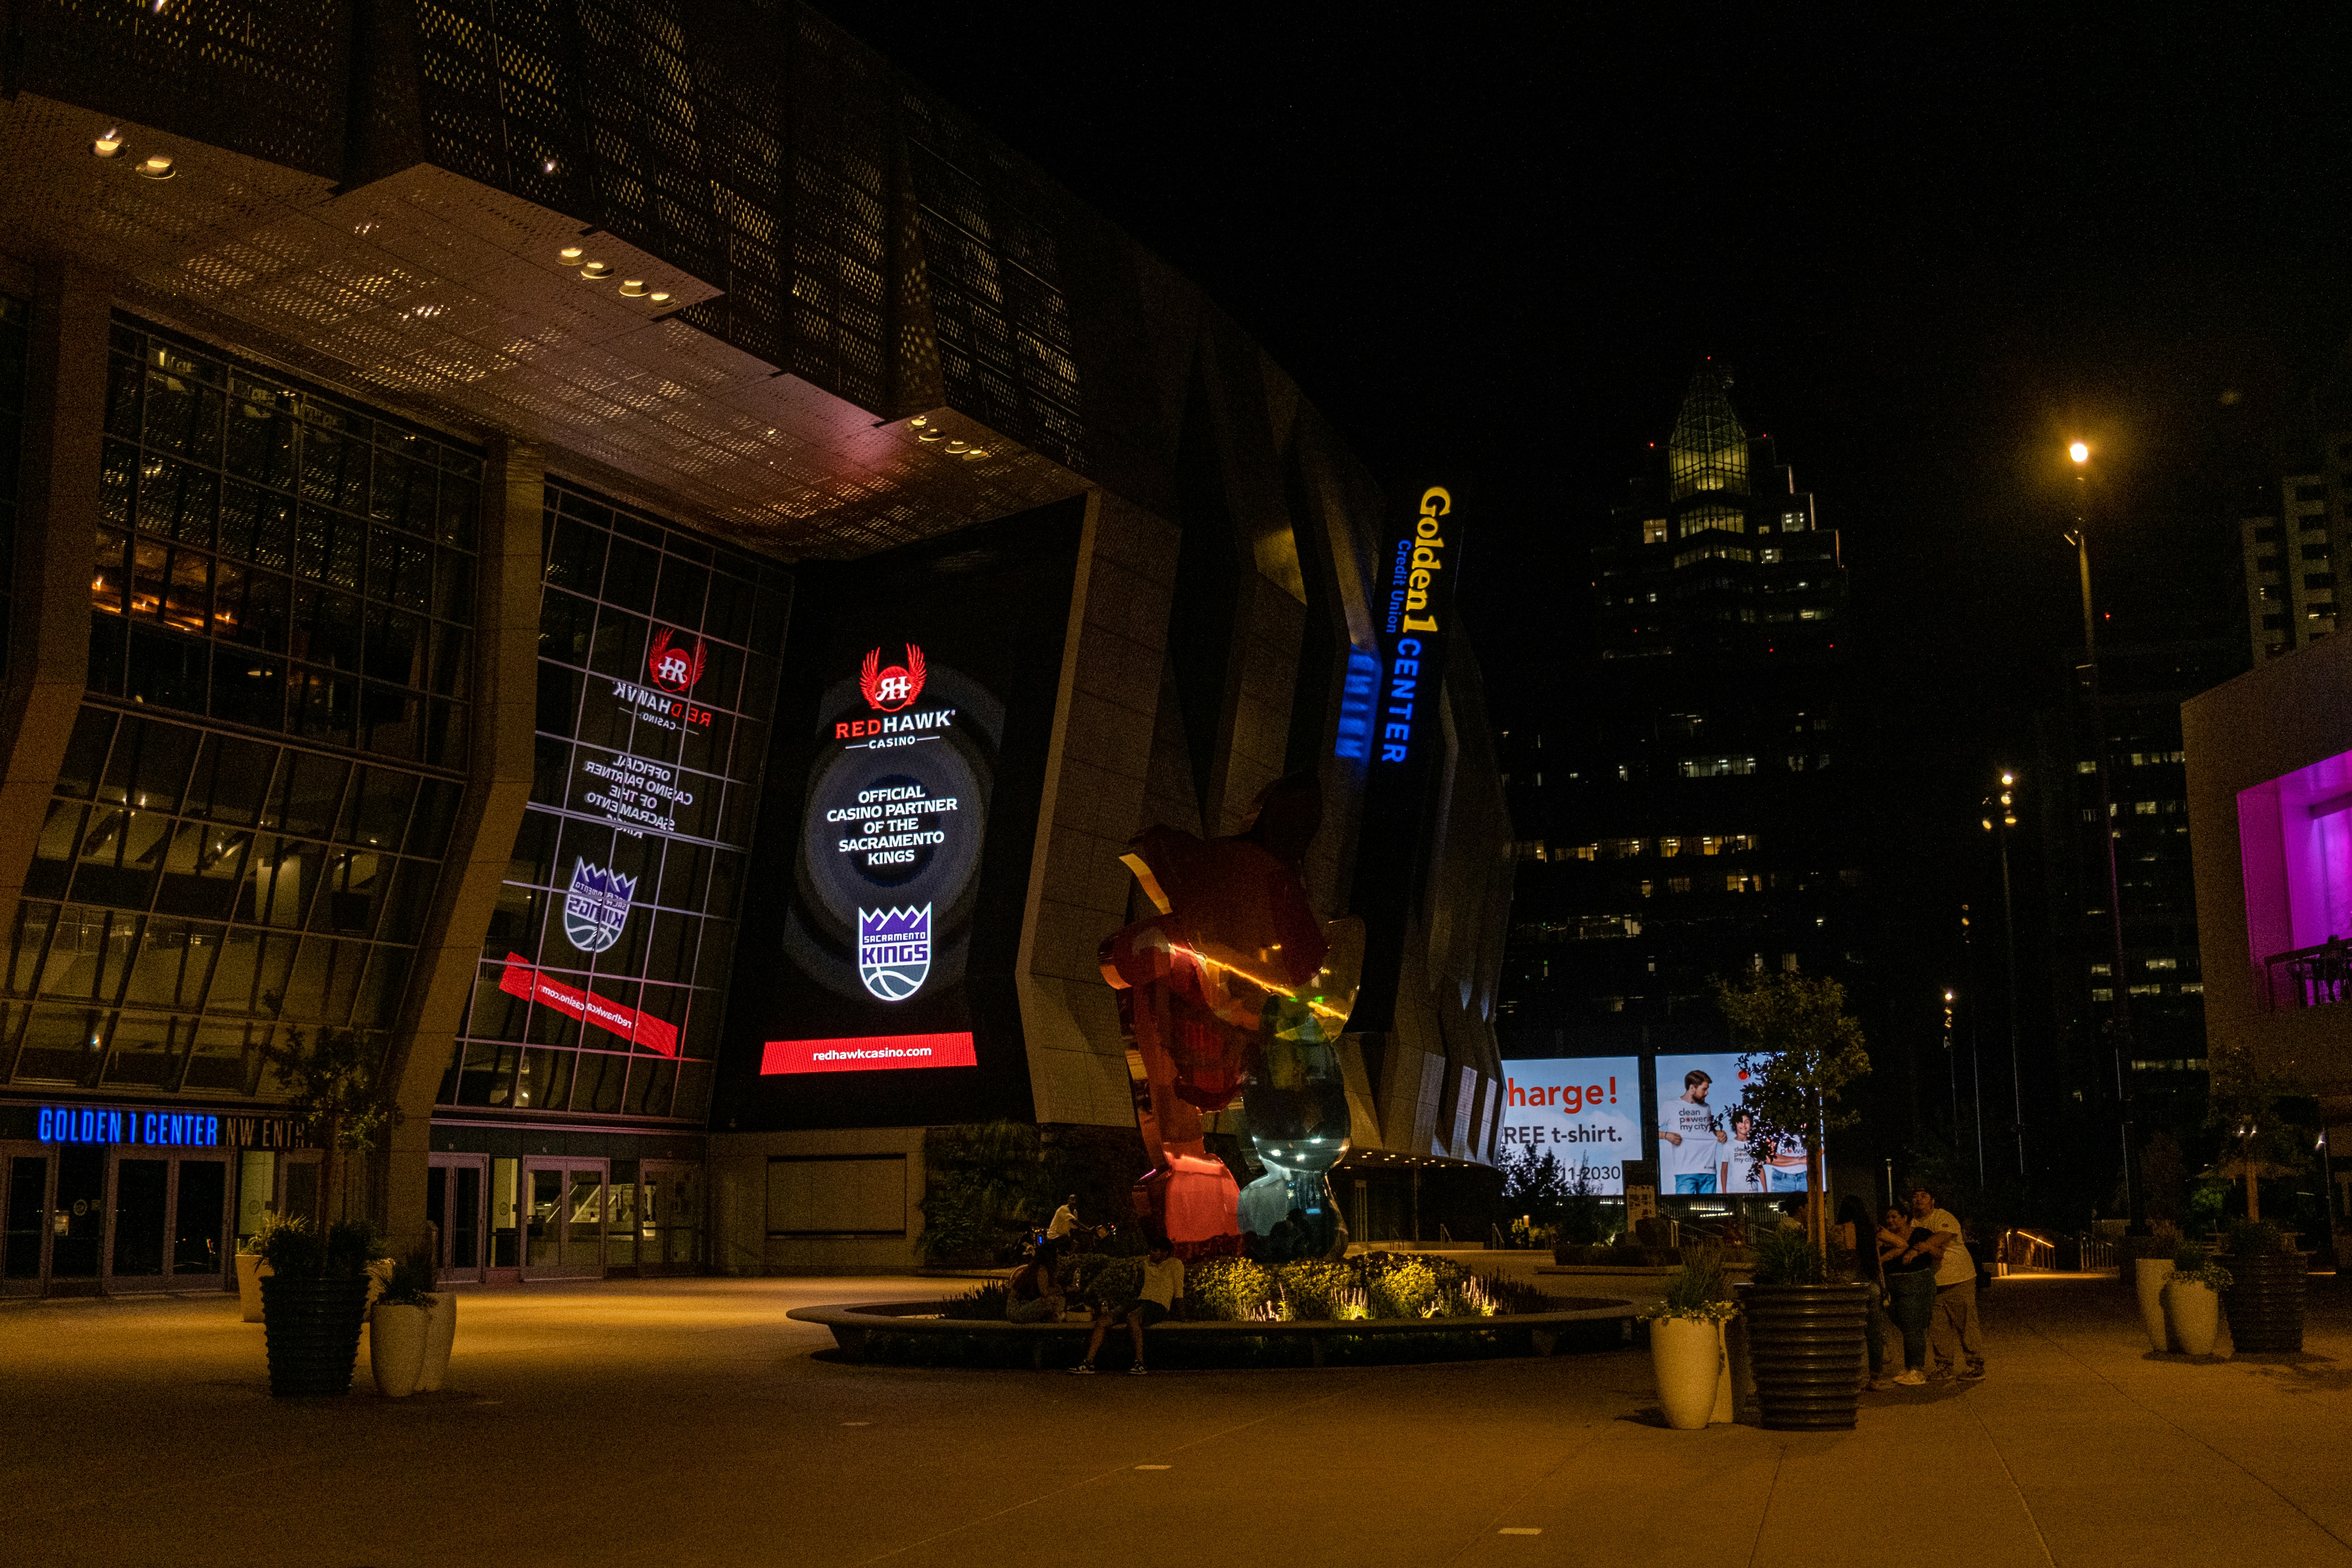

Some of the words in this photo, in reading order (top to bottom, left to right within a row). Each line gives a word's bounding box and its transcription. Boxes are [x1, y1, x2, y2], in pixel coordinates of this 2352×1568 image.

[1405, 486, 1451, 611] Golden
[1393, 539, 1412, 586] Credit
[1386, 590, 1405, 633] Union
[1402, 615, 1438, 633] 1
[1381, 638, 1422, 763] CENTER
[868, 735, 916, 749] CASINO
[858, 785, 926, 803] OFFICIAL
[827, 805, 882, 822] CASINO
[885, 798, 958, 816] PARTNER
[864, 821, 884, 834] OF
[887, 817, 919, 832] THE
[838, 831, 945, 852] SACRAMENTO
[867, 849, 915, 866] KINGS
[864, 932, 926, 943] SACRAMENTO
[862, 944, 928, 965] KINGS
[813, 1047, 932, 1060] redhawkcasino.com
[1508, 1076, 1617, 1114] harge!
[40, 1109, 121, 1143] GOLDEN
[129, 1111, 137, 1144] 1
[145, 1114, 218, 1146] CENTER
[226, 1117, 255, 1146] NW
[1504, 1126, 1545, 1144] REE
[1551, 1124, 1622, 1143] t-shirt.
[1694, 1123, 1710, 1132] city
[1560, 1166, 1621, 1180] 11-2030
